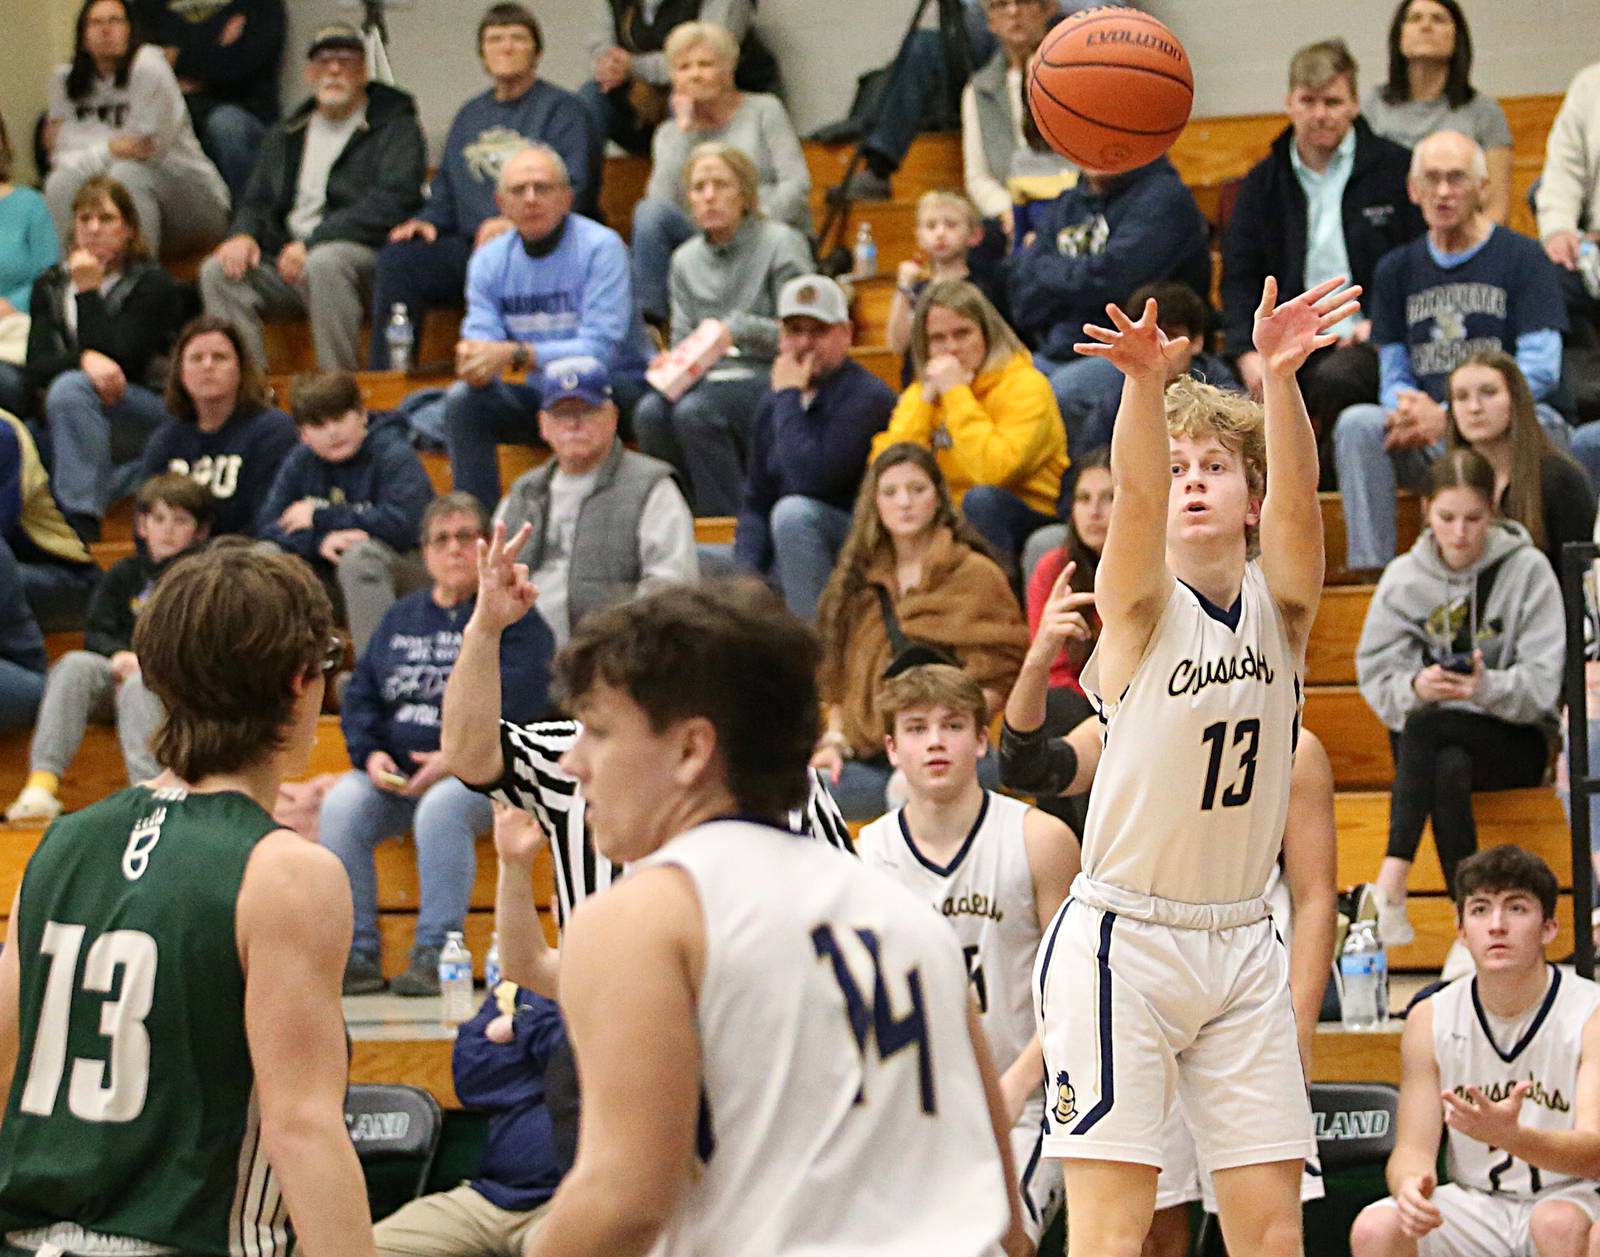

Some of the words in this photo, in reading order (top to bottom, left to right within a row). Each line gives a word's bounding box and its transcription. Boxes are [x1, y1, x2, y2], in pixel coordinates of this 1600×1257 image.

[1086, 29, 1183, 62] EVOLUTION
[1200, 717, 1261, 810] 13
[19, 920, 159, 1123] 13
[811, 924, 936, 1116] 14
[1312, 1109, 1391, 1141] LAND
